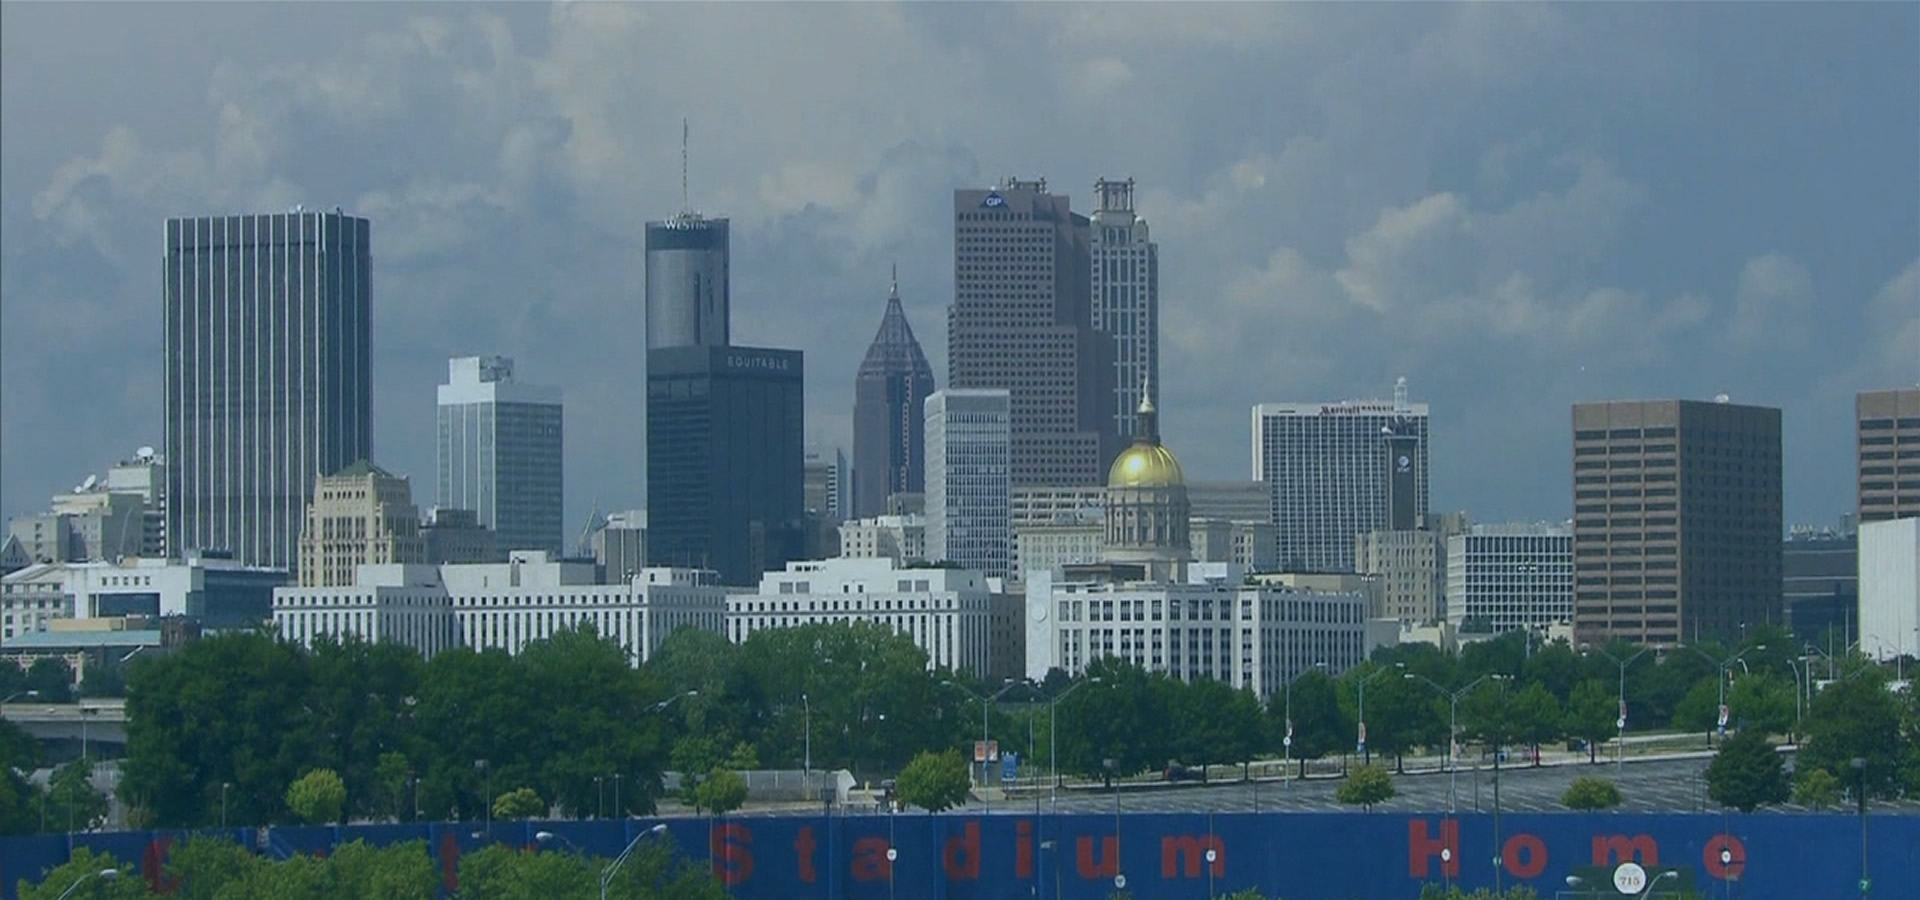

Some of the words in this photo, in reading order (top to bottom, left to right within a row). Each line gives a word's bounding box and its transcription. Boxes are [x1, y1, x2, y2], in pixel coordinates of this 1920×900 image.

[986, 197, 1002, 206] GP
[727, 356, 789, 371] EQUITABLE
[711, 821, 1226, 884] Stadium
[1409, 819, 1746, 878] Home
[1619, 876, 1640, 885] 715
